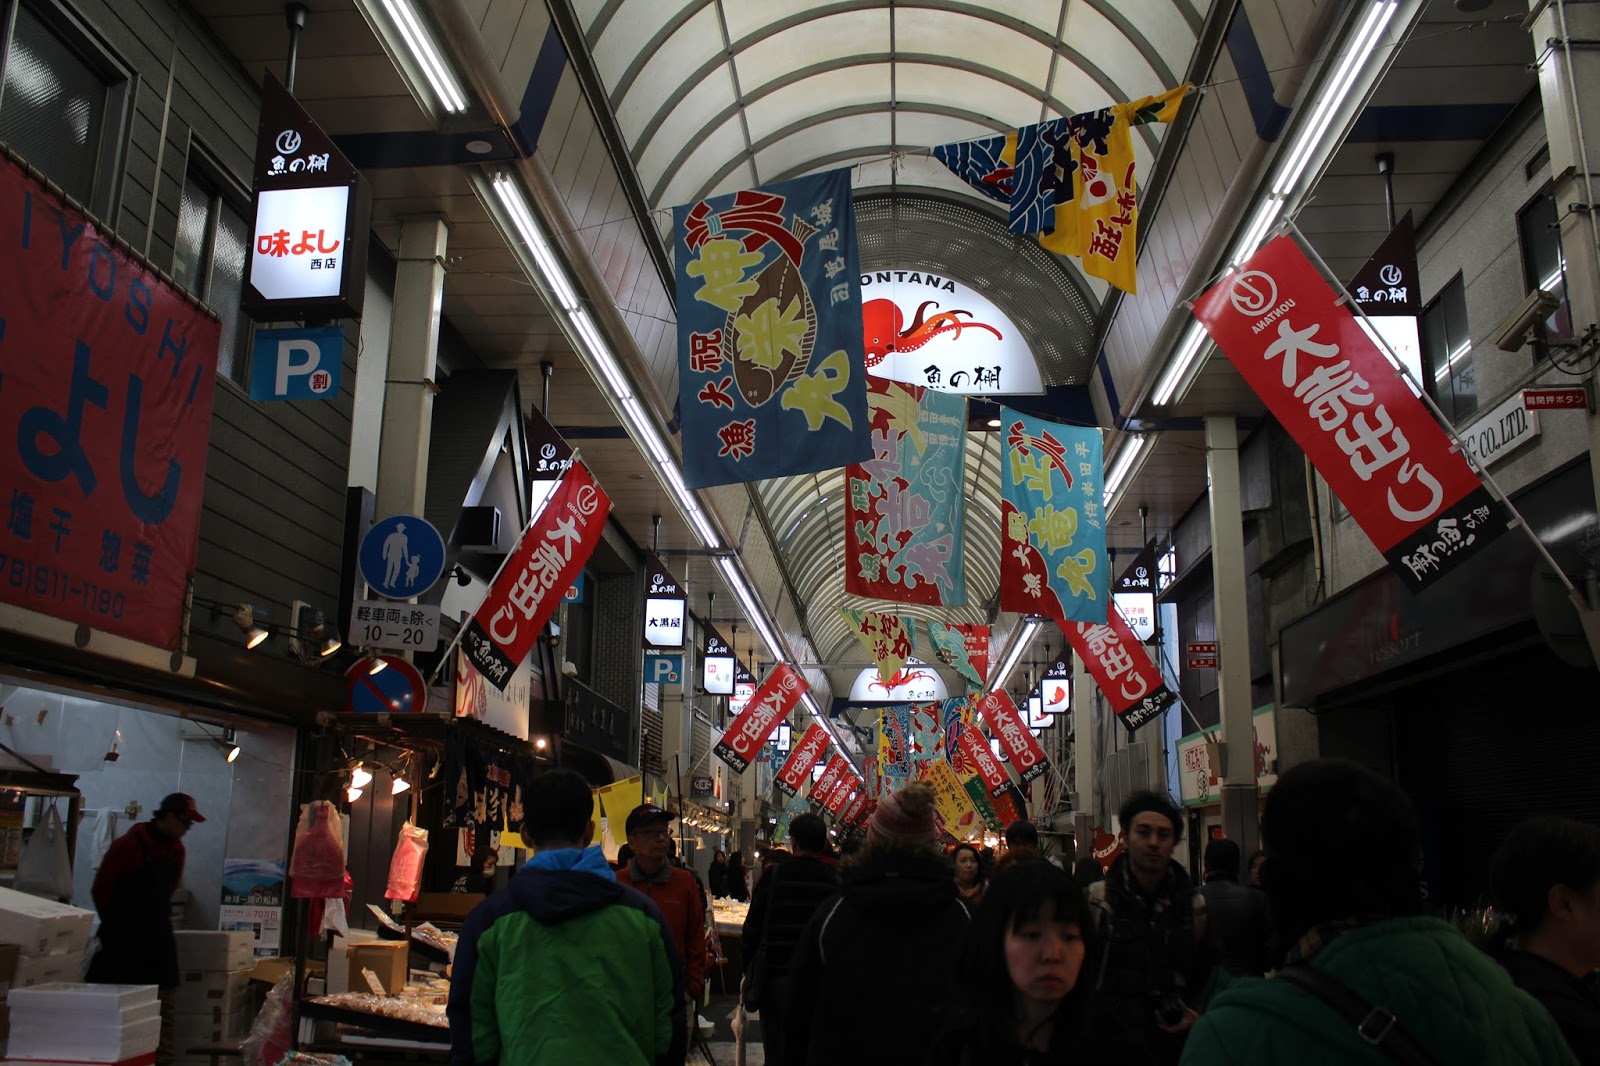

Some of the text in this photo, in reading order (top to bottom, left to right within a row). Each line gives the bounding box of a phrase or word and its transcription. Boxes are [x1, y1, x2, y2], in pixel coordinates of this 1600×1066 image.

[267, 153, 330, 177] 魚の棚
[257, 229, 340, 258] 味よし
[310, 258, 337, 270] 西店
[1355, 286, 1408, 304] 魚の棚
[275, 339, 321, 396] P
[923, 364, 1002, 390] 魚の棚
[312, 373, 329, 390] 割
[489, 514, 582, 646] 大売出し
[356, 605, 434, 627] 軽車両を除く
[648, 617, 681, 628] 大黒屋
[654, 659, 674, 682] P
[731, 689, 787, 753] 大売出し
